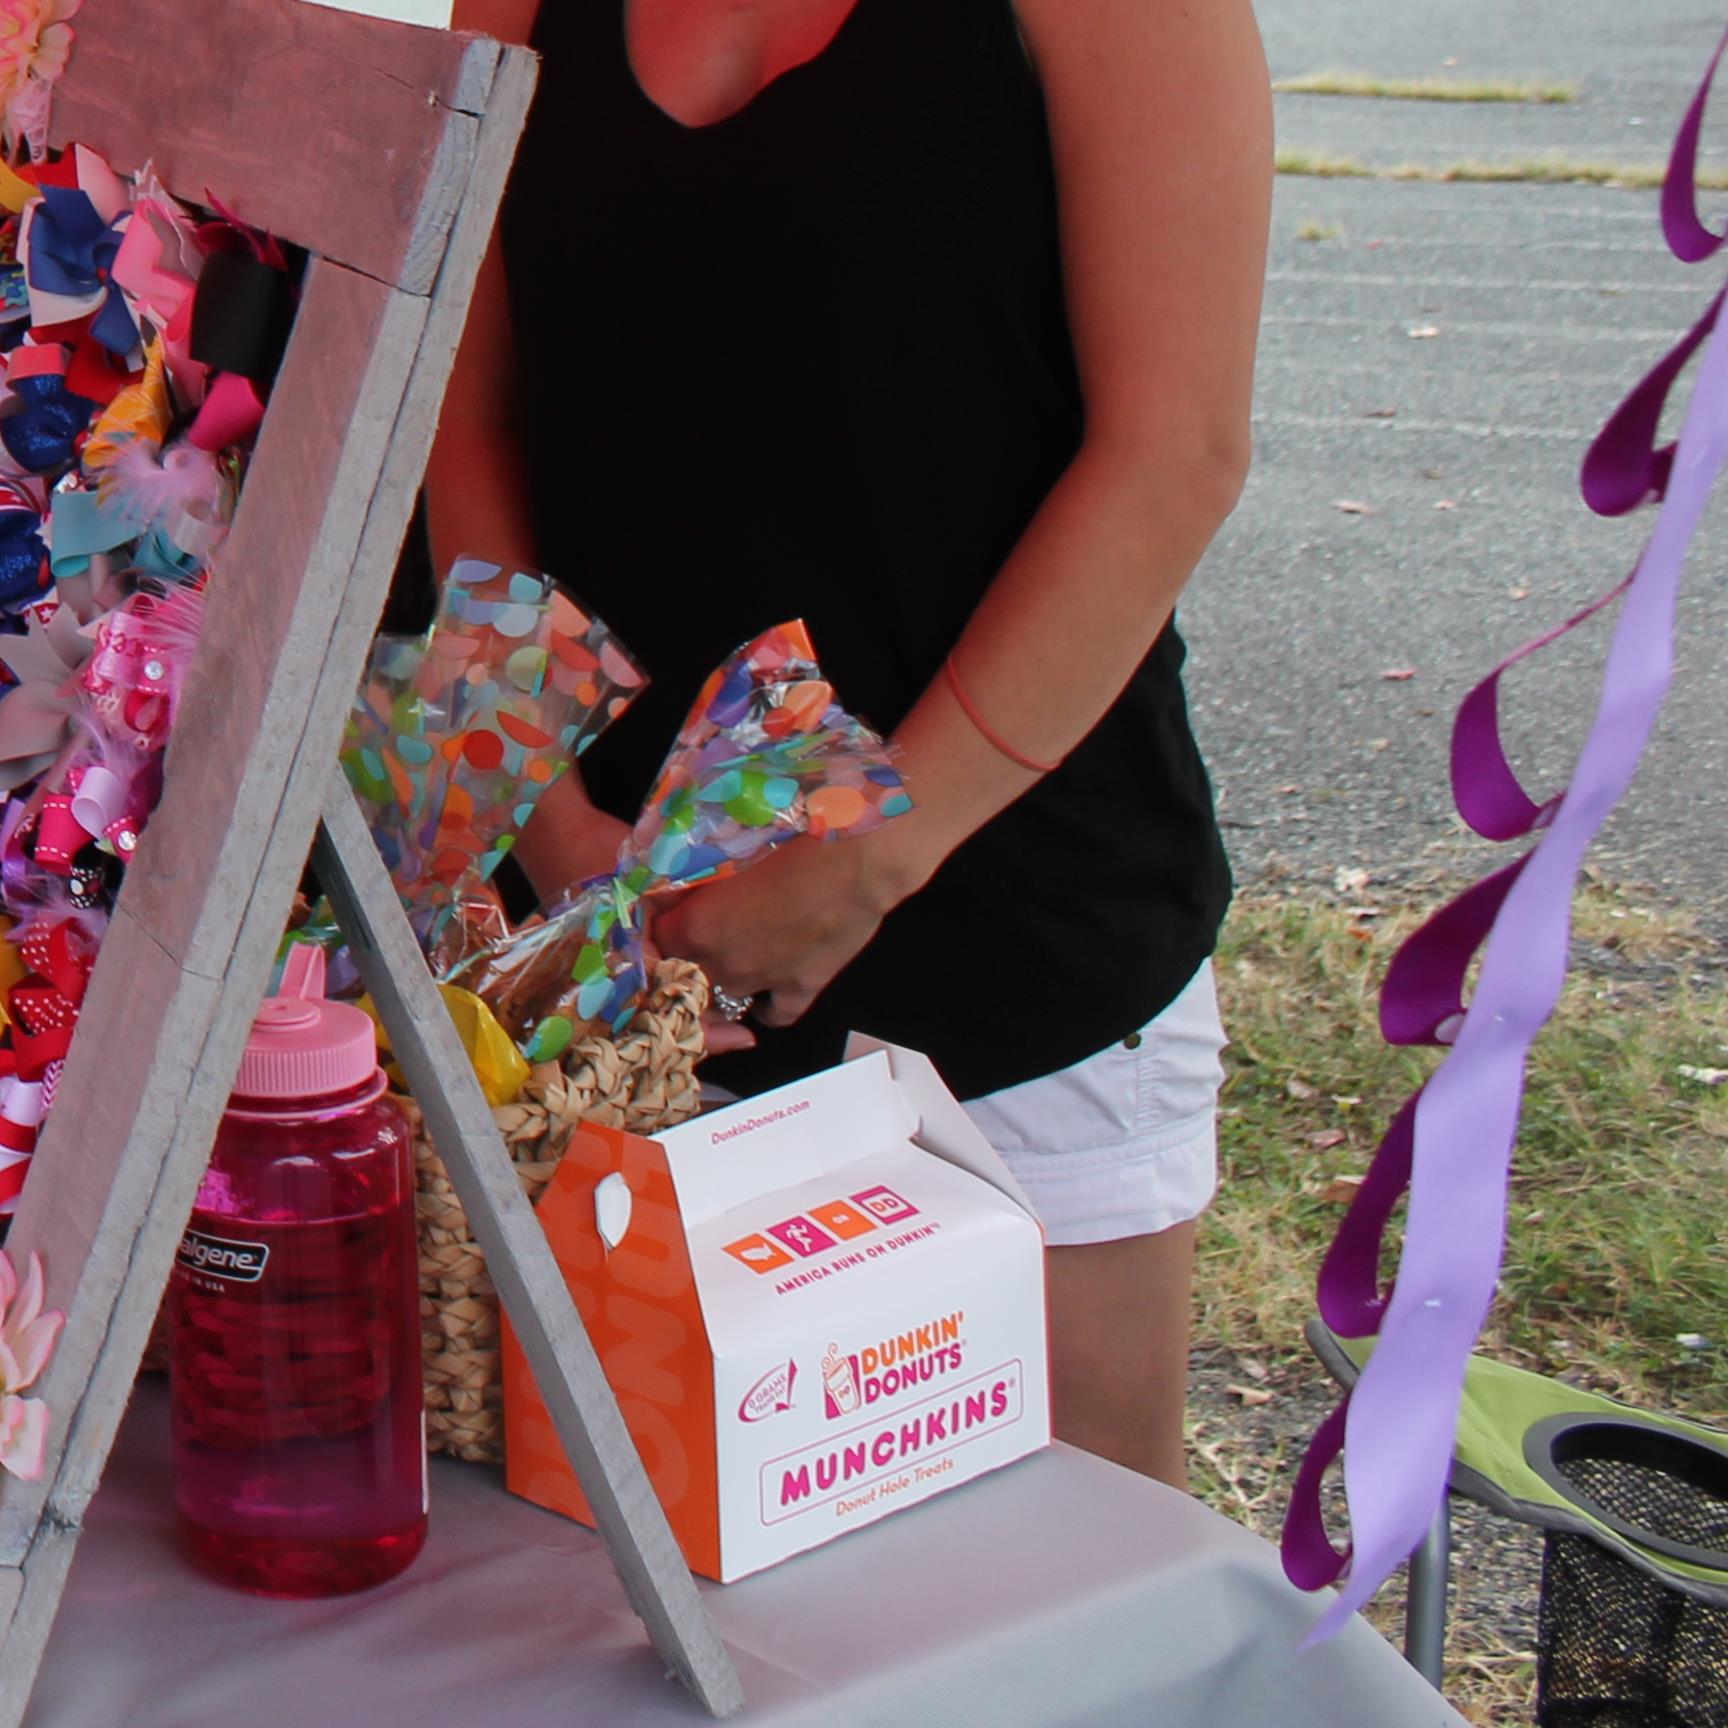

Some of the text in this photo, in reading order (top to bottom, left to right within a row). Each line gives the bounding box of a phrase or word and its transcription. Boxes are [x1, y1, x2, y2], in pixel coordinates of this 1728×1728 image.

[710, 1100, 811, 1145] DunkinDonuts.com
[869, 1197, 899, 1214] DD
[180, 1236, 253, 1271] algene
[774, 1266, 832, 1295] AMERICA
[832, 1251, 866, 1273] RUNS
[867, 1242, 888, 1260] ON
[860, 1310, 964, 1374] DUNKIN'
[755, 1373, 787, 1403] GRAMS
[863, 1342, 962, 1404] DONUTS
[835, 1457, 955, 1517] Donut Hole Treats
